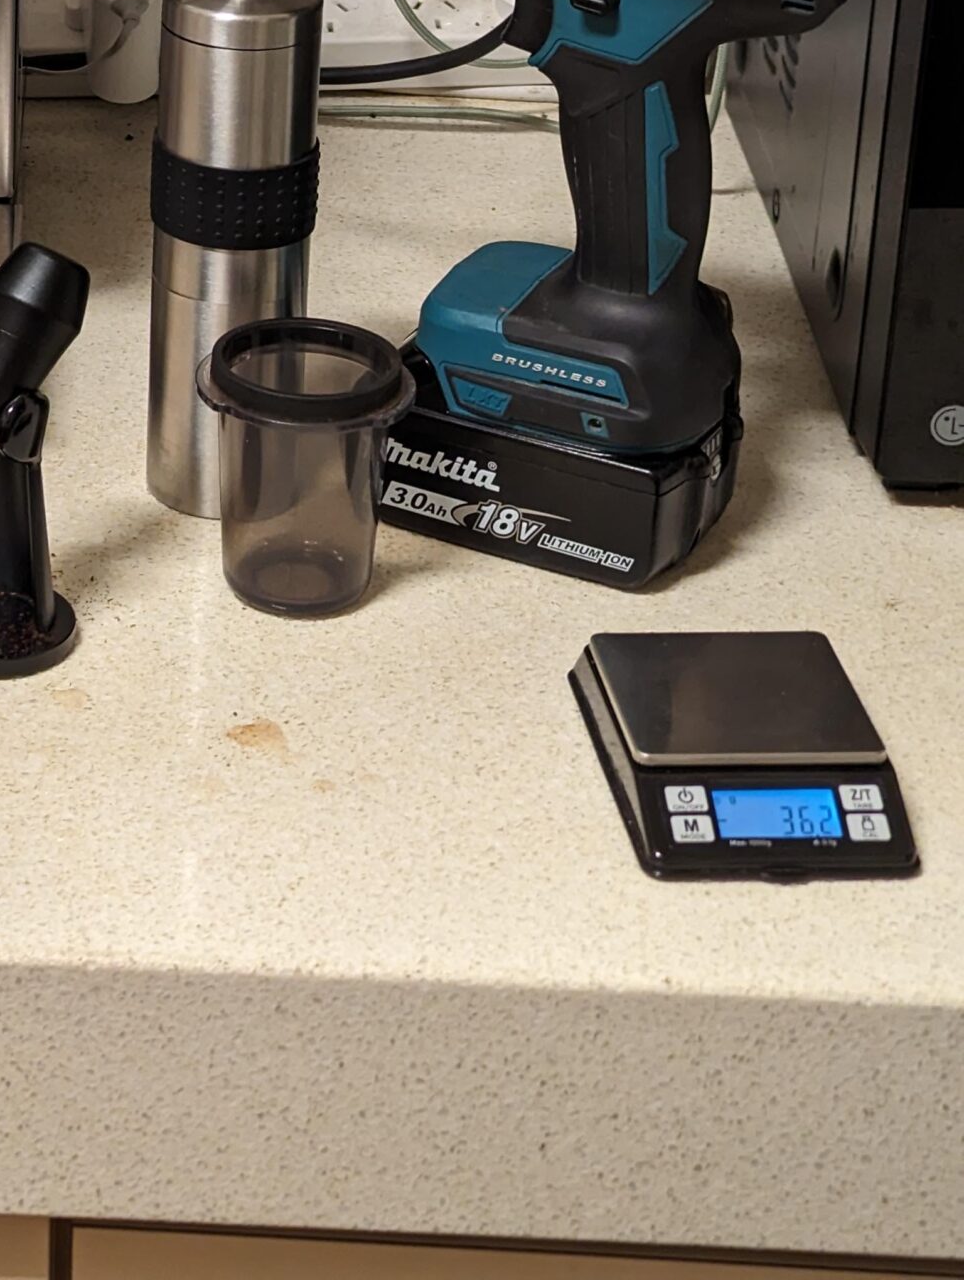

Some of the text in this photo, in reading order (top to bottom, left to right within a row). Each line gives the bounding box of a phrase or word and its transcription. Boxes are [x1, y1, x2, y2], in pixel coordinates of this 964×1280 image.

[491, 353, 607, 388] BRUSHLESS
[390, 487, 448, 518] 3.0Ah
[684, 818, 700, 832] M
